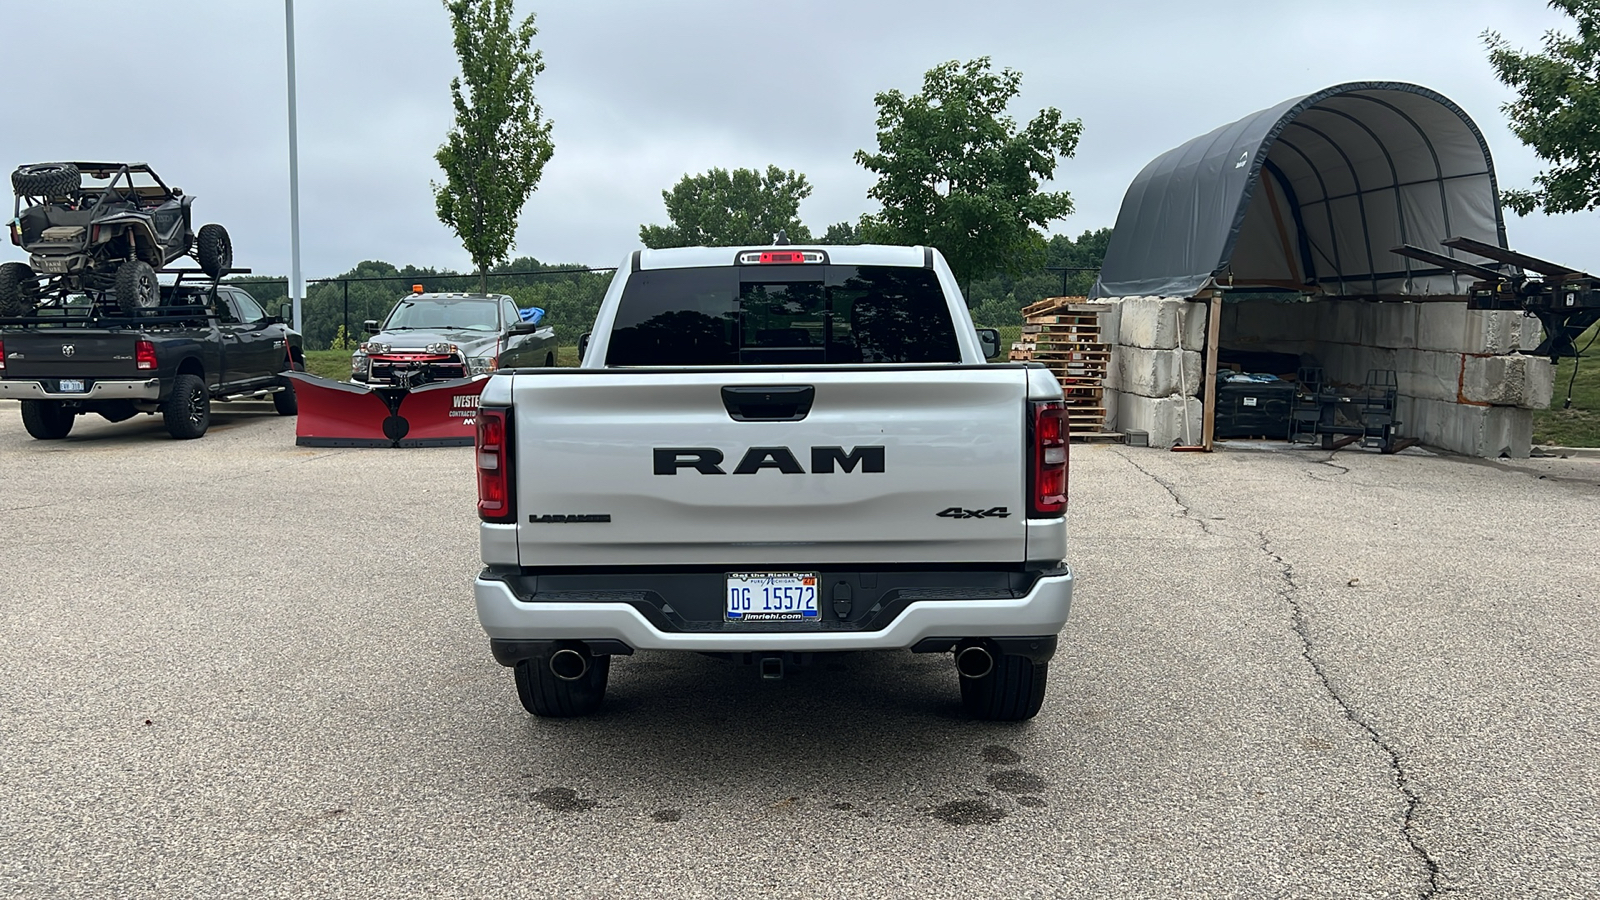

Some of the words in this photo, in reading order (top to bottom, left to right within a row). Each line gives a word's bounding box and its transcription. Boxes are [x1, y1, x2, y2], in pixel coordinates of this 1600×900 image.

[453, 395, 480, 408] WESTE
[653, 445, 886, 475] RAM
[935, 506, 1012, 519] 4x4
[731, 588, 751, 610] DG
[763, 587, 815, 610] 15572
[744, 613, 801, 621] jimriehl.com
